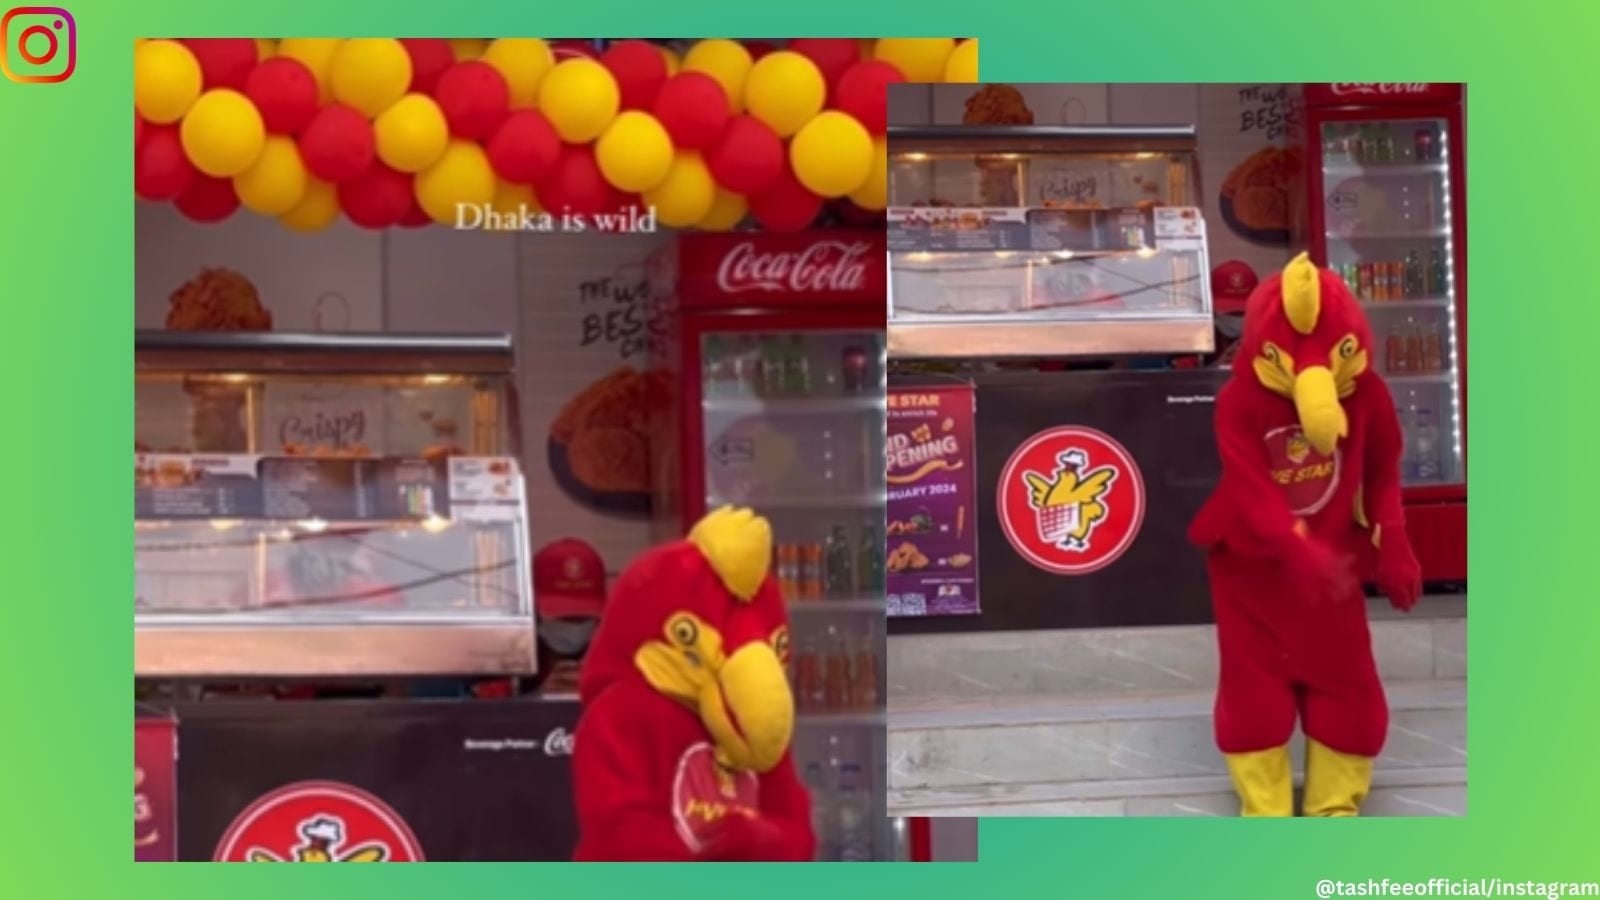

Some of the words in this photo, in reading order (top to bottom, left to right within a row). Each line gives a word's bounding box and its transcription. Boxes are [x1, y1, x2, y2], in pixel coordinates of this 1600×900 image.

[1240, 104, 1282, 132] BES
[717, 241, 873, 293] Coca-Cola
[579, 304, 643, 346] BES
[900, 393, 940, 407] STAR
[928, 483, 957, 496] 2024
